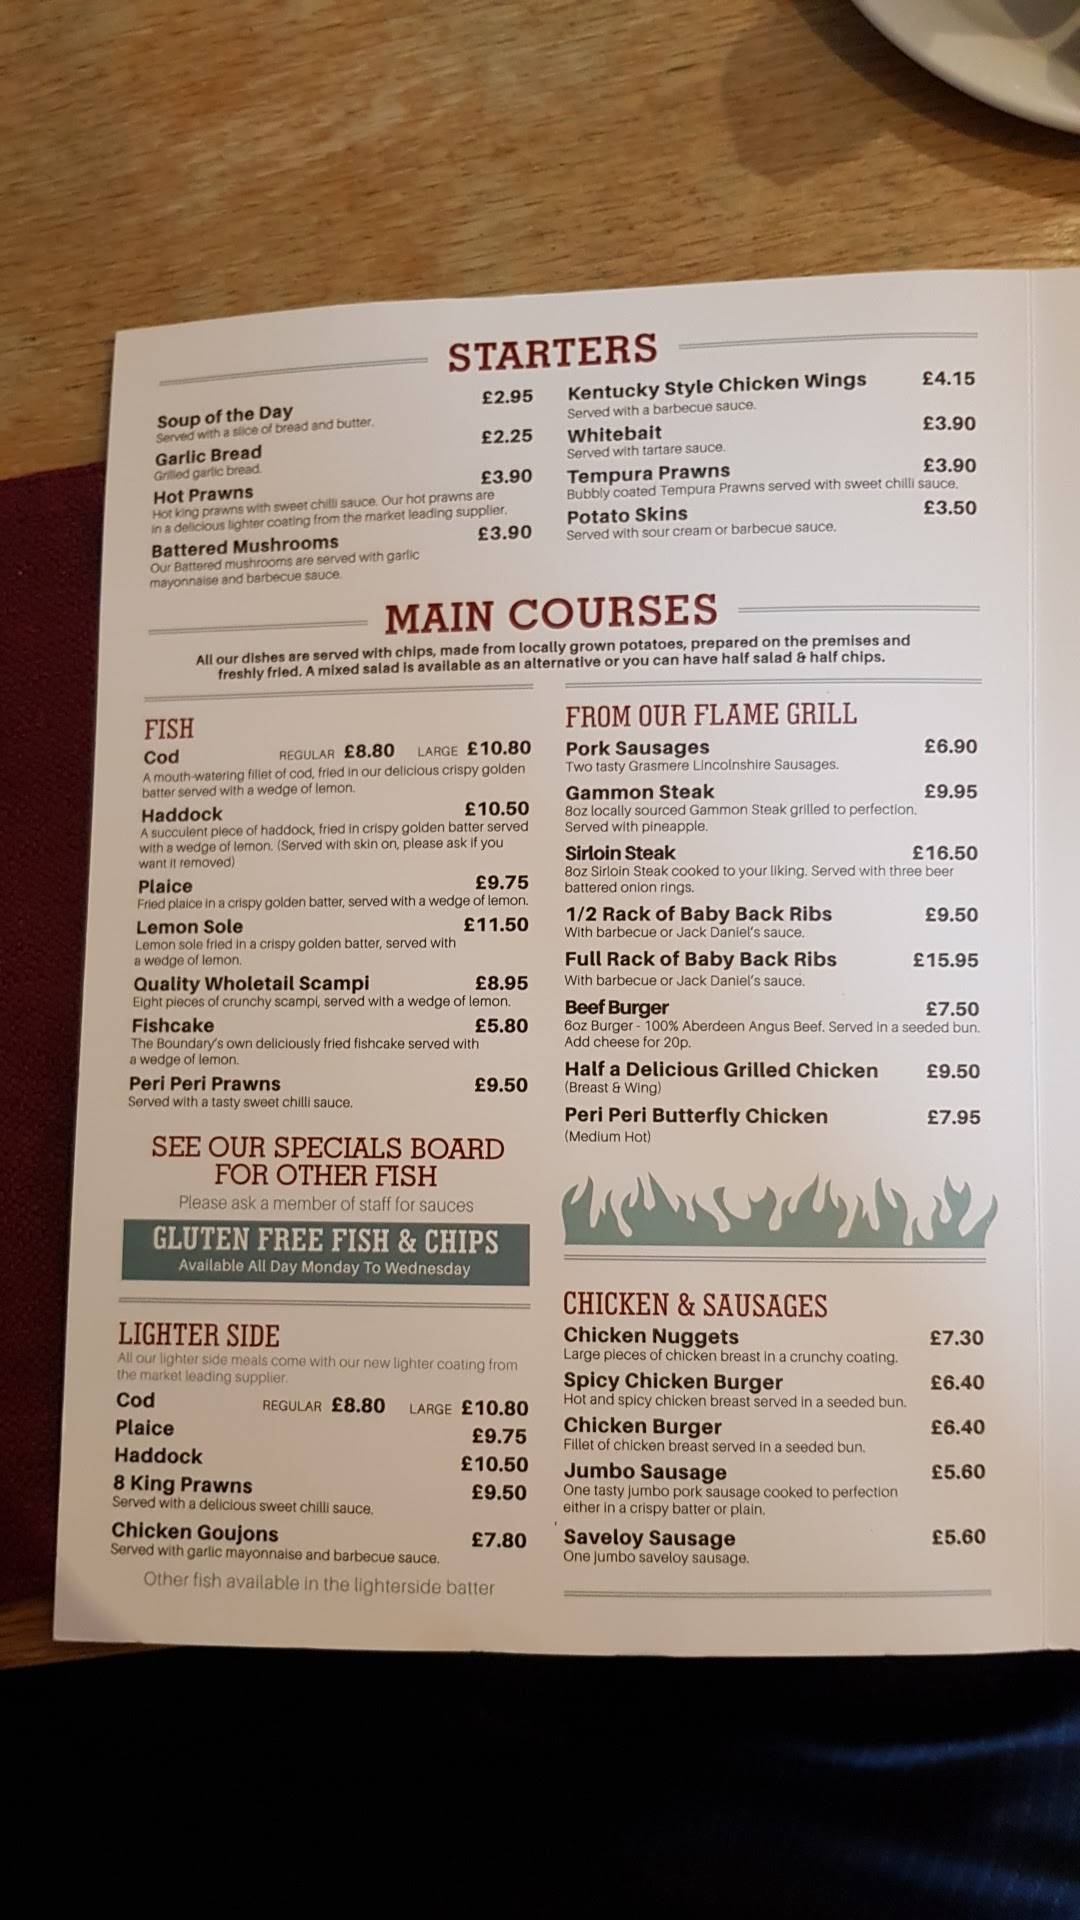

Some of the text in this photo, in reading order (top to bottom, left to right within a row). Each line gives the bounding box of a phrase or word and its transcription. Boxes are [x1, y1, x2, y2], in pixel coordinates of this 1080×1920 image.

[449, 333, 657, 372] STARTERS
[569, 373, 866, 401] Kentucky Style Chicken Wings
[923, 371, 975, 386] £4.15
[482, 389, 533, 404] £2.95
[157, 406, 293, 429] Soup of the Day
[567, 401, 756, 419] Served with a barbecue sauce.
[923, 416, 976, 431] £3.90
[568, 425, 662, 443] Whitebait
[566, 443, 725, 459] Served with tartare sauce.
[481, 469, 532, 485] £3.90
[154, 488, 253, 504] Hot Prawns
[568, 506, 688, 525] Potato Skins
[924, 500, 977, 515] £3.50
[478, 525, 532, 541] £3.90
[152, 537, 339, 558] Battered Mushrooms
[385, 593, 717, 635] MAIN COURSES
[566, 702, 857, 728] FROM OUR FLAME GRILL
[145, 717, 194, 740] FISH
[144, 749, 179, 765] Cod
[279, 743, 395, 760] REGULAR £8.80
[418, 740, 531, 757] LARGE £10.80
[565, 758, 839, 775] Two tasty Grasmere Lincolnshire Sausages.
[142, 782, 355, 799] batter served with a wedge of lemon.
[566, 784, 714, 800] Gammon Steak
[925, 784, 977, 799] £9.95
[142, 806, 223, 823] Haddock
[465, 801, 529, 816] £10.50
[138, 855, 235, 869] want it removed)
[139, 879, 193, 894] Plaice
[476, 875, 529, 890] £9.75
[567, 905, 832, 925] 1/2 Rack of Baby Back Ribs
[925, 907, 978, 922] £9.50
[134, 975, 369, 995] Quality Wholetail Scampi
[476, 976, 528, 991] £8.95
[566, 999, 669, 1019] Beef Burger
[926, 1001, 979, 1016] £7.50
[133, 1017, 214, 1033] Fishcake
[475, 1018, 528, 1033] £5.80
[565, 1035, 691, 1050] Add cheese for 20p.
[565, 1106, 827, 1127] Peri Peri Butterfly Chicken
[928, 1109, 981, 1125] £7.95
[565, 1129, 650, 1144] (Medium Hot)
[152, 1136, 504, 1160] SEE OUR SPECIALS BOARD
[215, 1163, 437, 1187] FOR OTHER FISH
[154, 1225, 498, 1254] GLUTEN FREE FISH & CHIPS
[179, 1258, 470, 1279] Available All Day Monday To Wednesday
[564, 1291, 827, 1318] CHICKEN & SAUSAGES
[119, 1322, 279, 1347] LIGHTER SIDE
[564, 1326, 739, 1348] Chicken Nuggets
[930, 1330, 984, 1346] £7.30
[564, 1371, 783, 1394] Spicy Chicken Burger
[931, 1375, 984, 1391] £6.40
[117, 1392, 155, 1408] Cod
[262, 1397, 385, 1413] REGULAR £8.80
[410, 1400, 528, 1416] LARGE £10.80
[564, 1462, 727, 1484] Jumbo Sausage
[932, 1464, 985, 1480] £5.60
[113, 1475, 252, 1496] 8 King Prawns
[472, 1484, 527, 1501] £9.50
[112, 1521, 278, 1545] Chicken Goujons
[472, 1532, 526, 1548] £7.80
[110, 1543, 440, 1564] Served with garlic mayonnaise and barbecue sauce.
[563, 1550, 749, 1567] One jumbo saveloy sausage.
